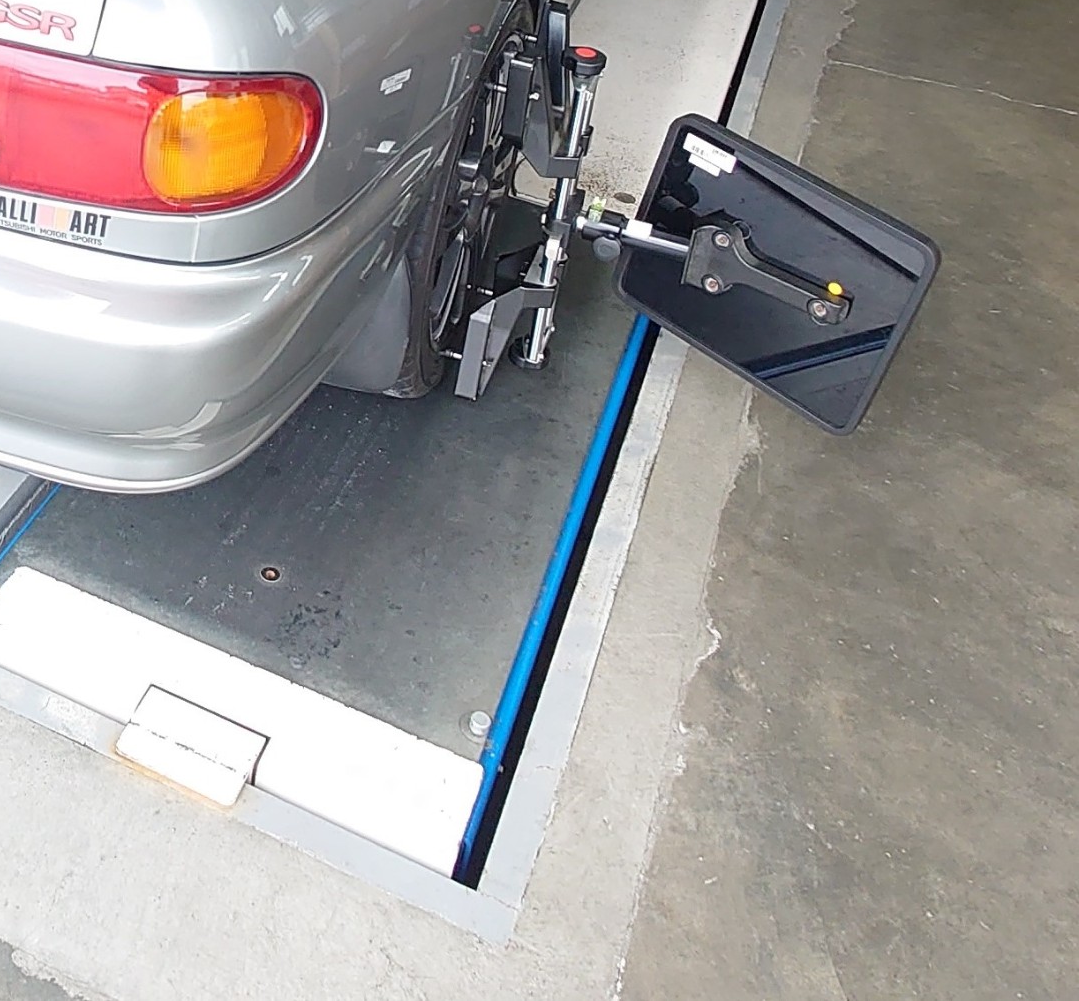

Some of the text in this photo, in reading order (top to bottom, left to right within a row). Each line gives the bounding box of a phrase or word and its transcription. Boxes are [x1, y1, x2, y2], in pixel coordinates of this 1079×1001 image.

[69, 210, 112, 238] ART
[39, 227, 68, 240] MOTOR
[71, 234, 103, 247] SPORTS
